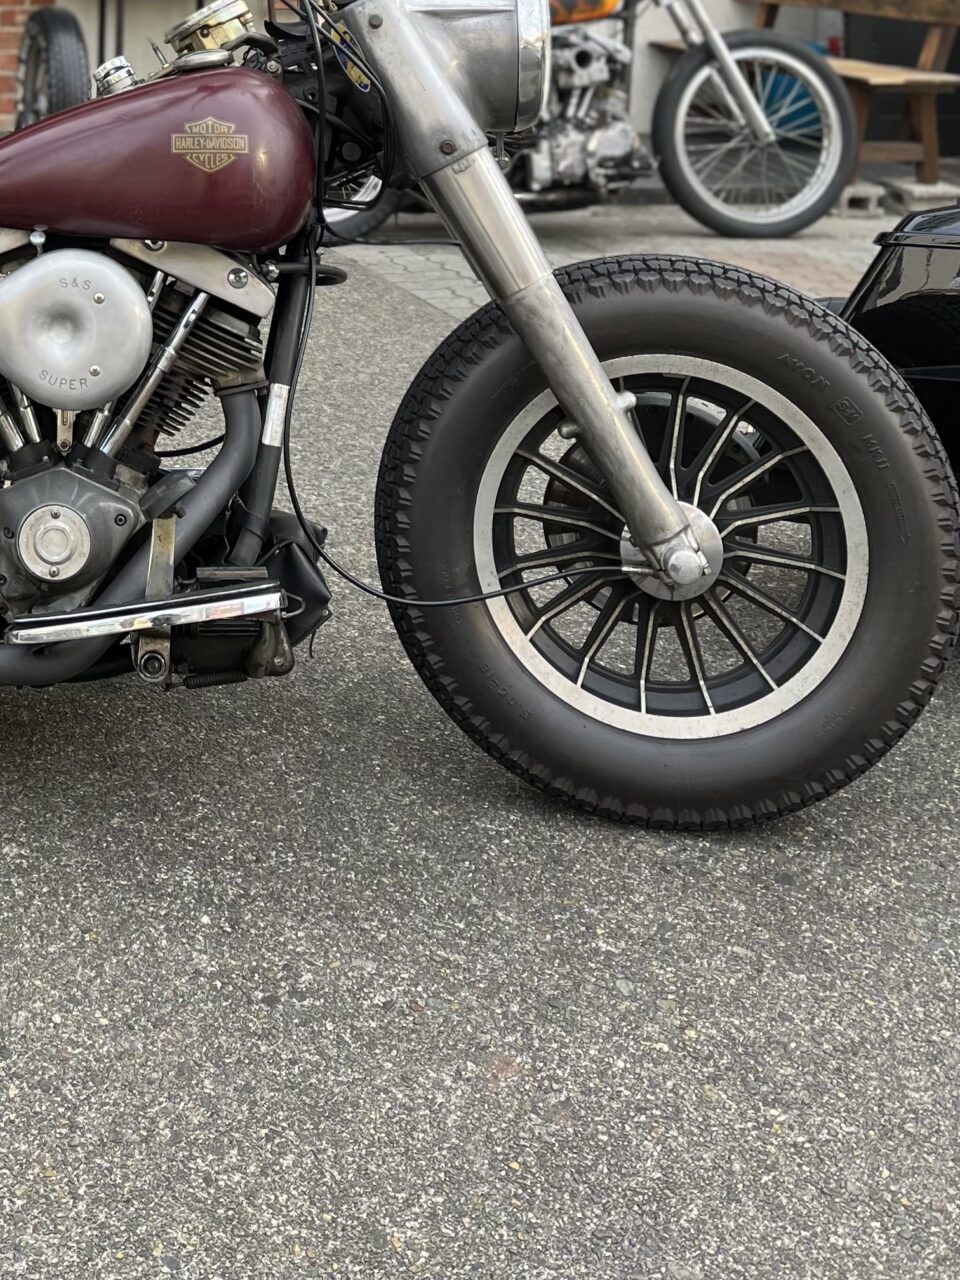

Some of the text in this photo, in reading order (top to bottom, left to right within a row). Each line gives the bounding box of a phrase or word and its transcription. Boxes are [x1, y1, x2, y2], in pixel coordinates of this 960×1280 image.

[192, 121, 228, 133] MOTOR
[175, 137, 245, 150] HARLEY-DAVIDSON
[193, 153, 228, 168] CYCLES
[58, 277, 92, 291] S&S
[39, 369, 89, 391] SUPER
